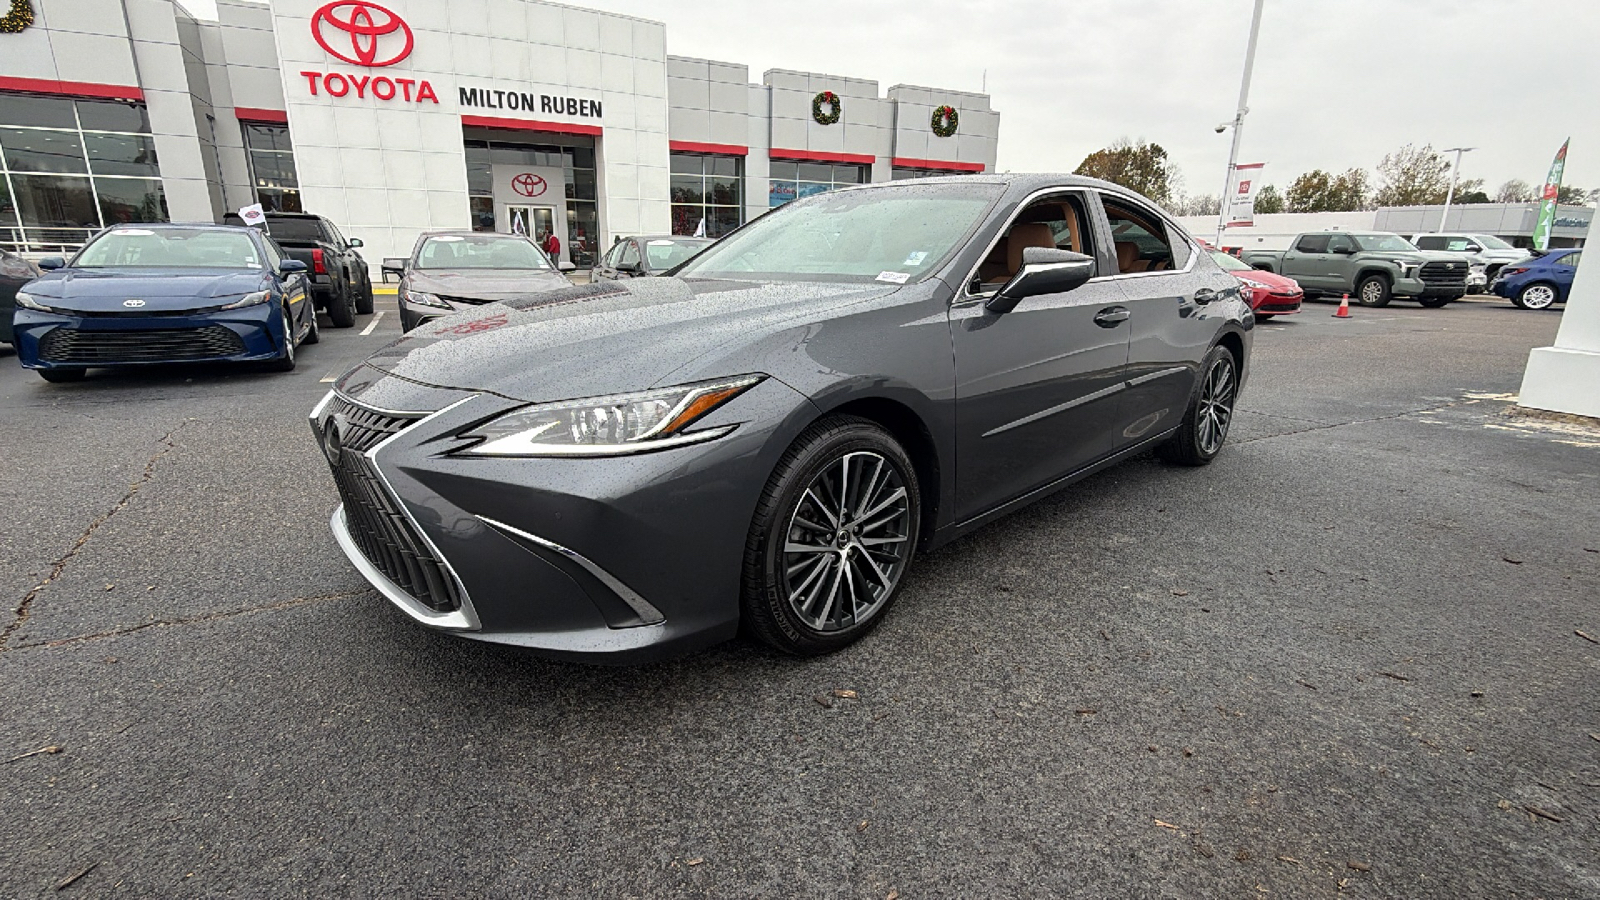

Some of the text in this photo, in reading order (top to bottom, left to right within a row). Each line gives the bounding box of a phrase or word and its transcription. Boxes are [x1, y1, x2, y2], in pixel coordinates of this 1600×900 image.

[299, 71, 439, 104] TOYOTA
[458, 87, 603, 119] MILTON RUBEN
